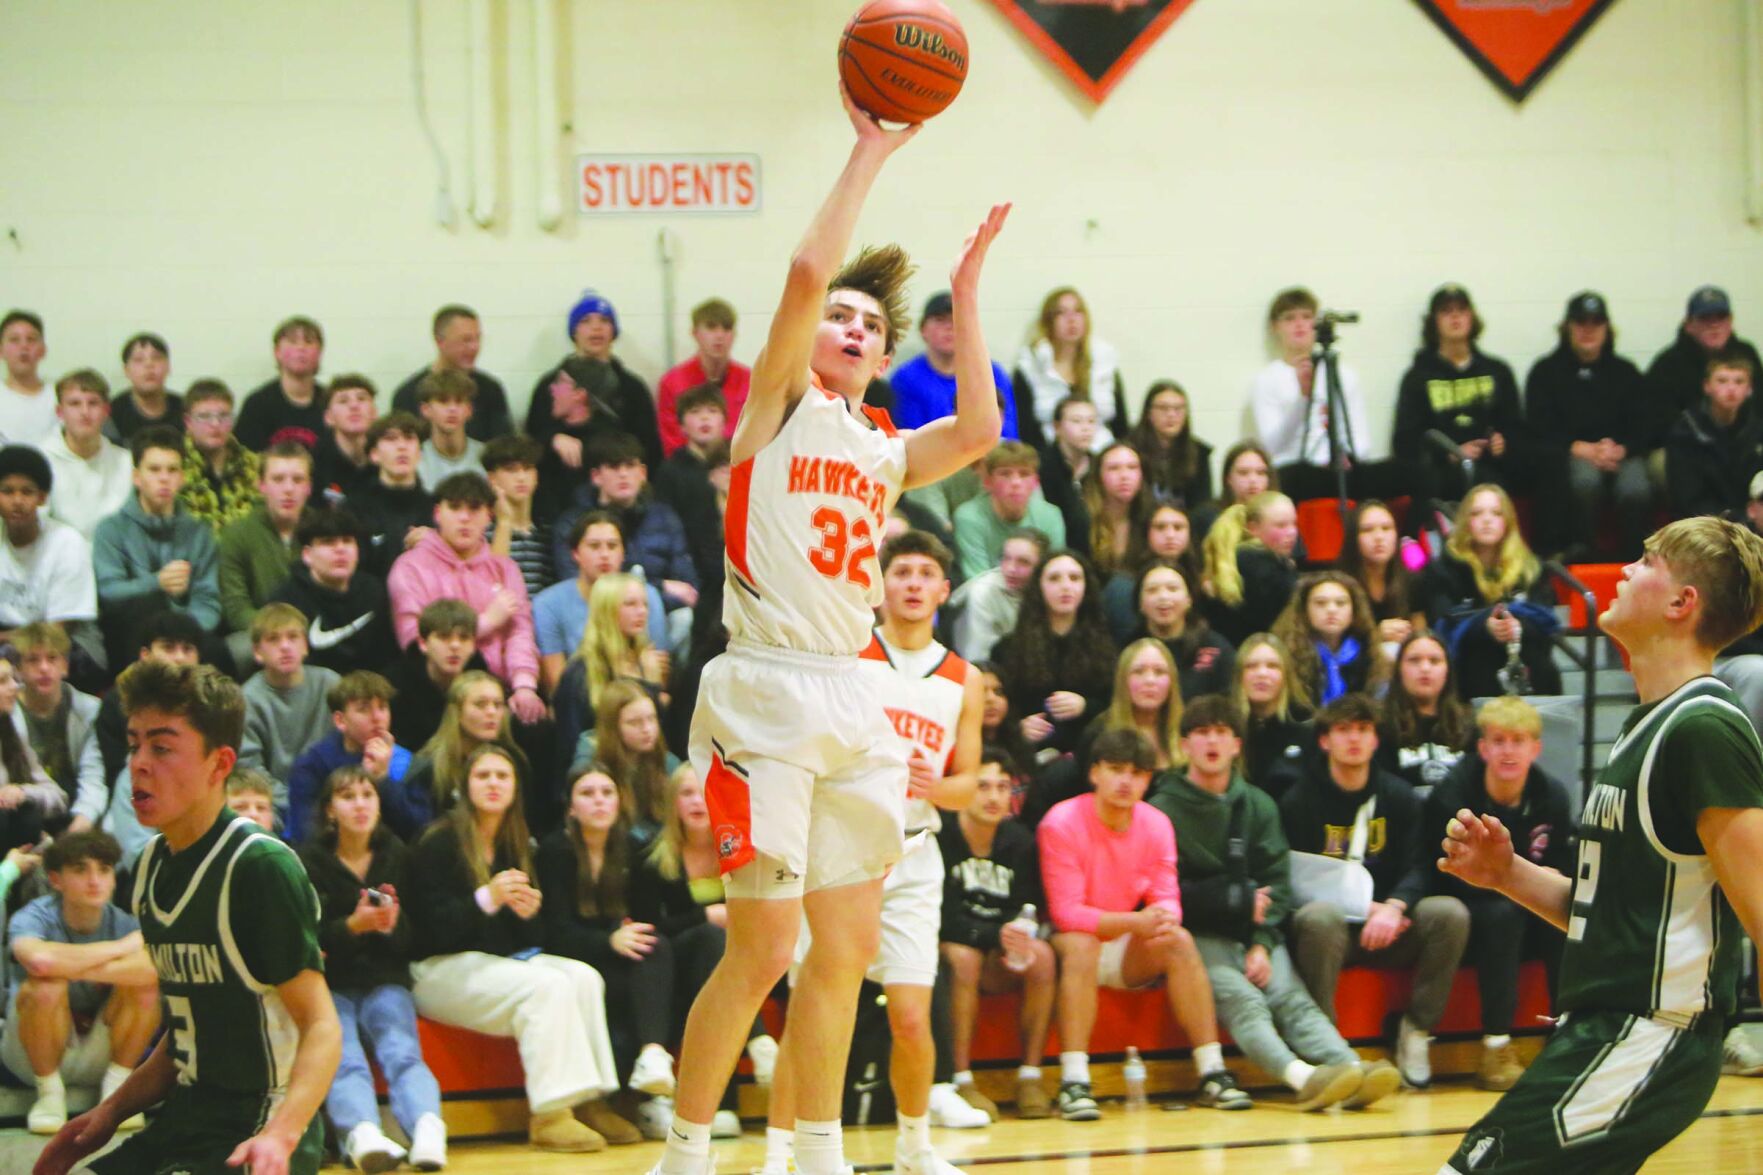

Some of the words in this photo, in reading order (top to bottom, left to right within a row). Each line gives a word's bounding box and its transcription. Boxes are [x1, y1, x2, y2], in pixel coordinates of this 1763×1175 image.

[895, 23, 965, 72] Wilson
[583, 162, 755, 207] STUDENTS
[808, 504, 876, 591] 32
